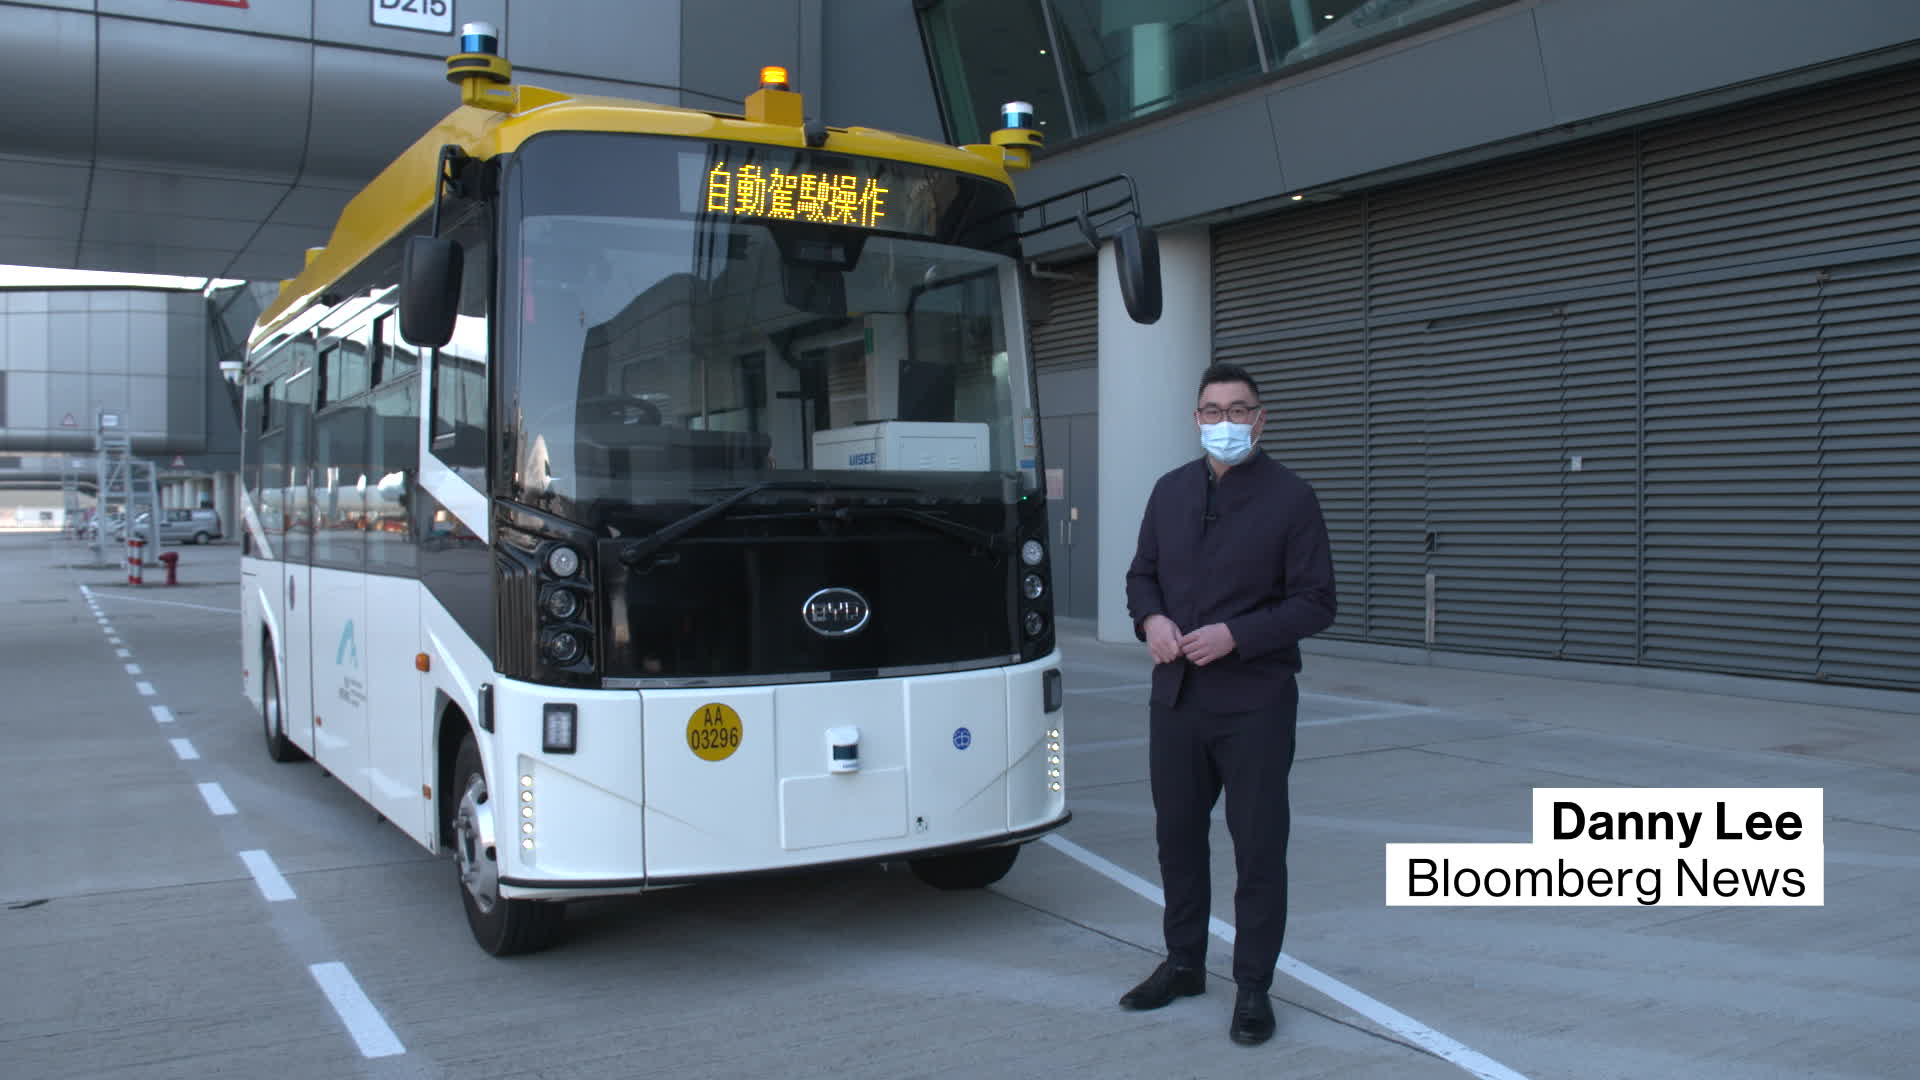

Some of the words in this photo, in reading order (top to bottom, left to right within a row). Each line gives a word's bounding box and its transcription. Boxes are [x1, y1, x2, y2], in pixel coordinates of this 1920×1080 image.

[707, 161, 890, 227] 自動駕駛操作
[811, 601, 860, 622] BYD
[704, 706, 723, 727] AA
[691, 726, 739, 751] 03296
